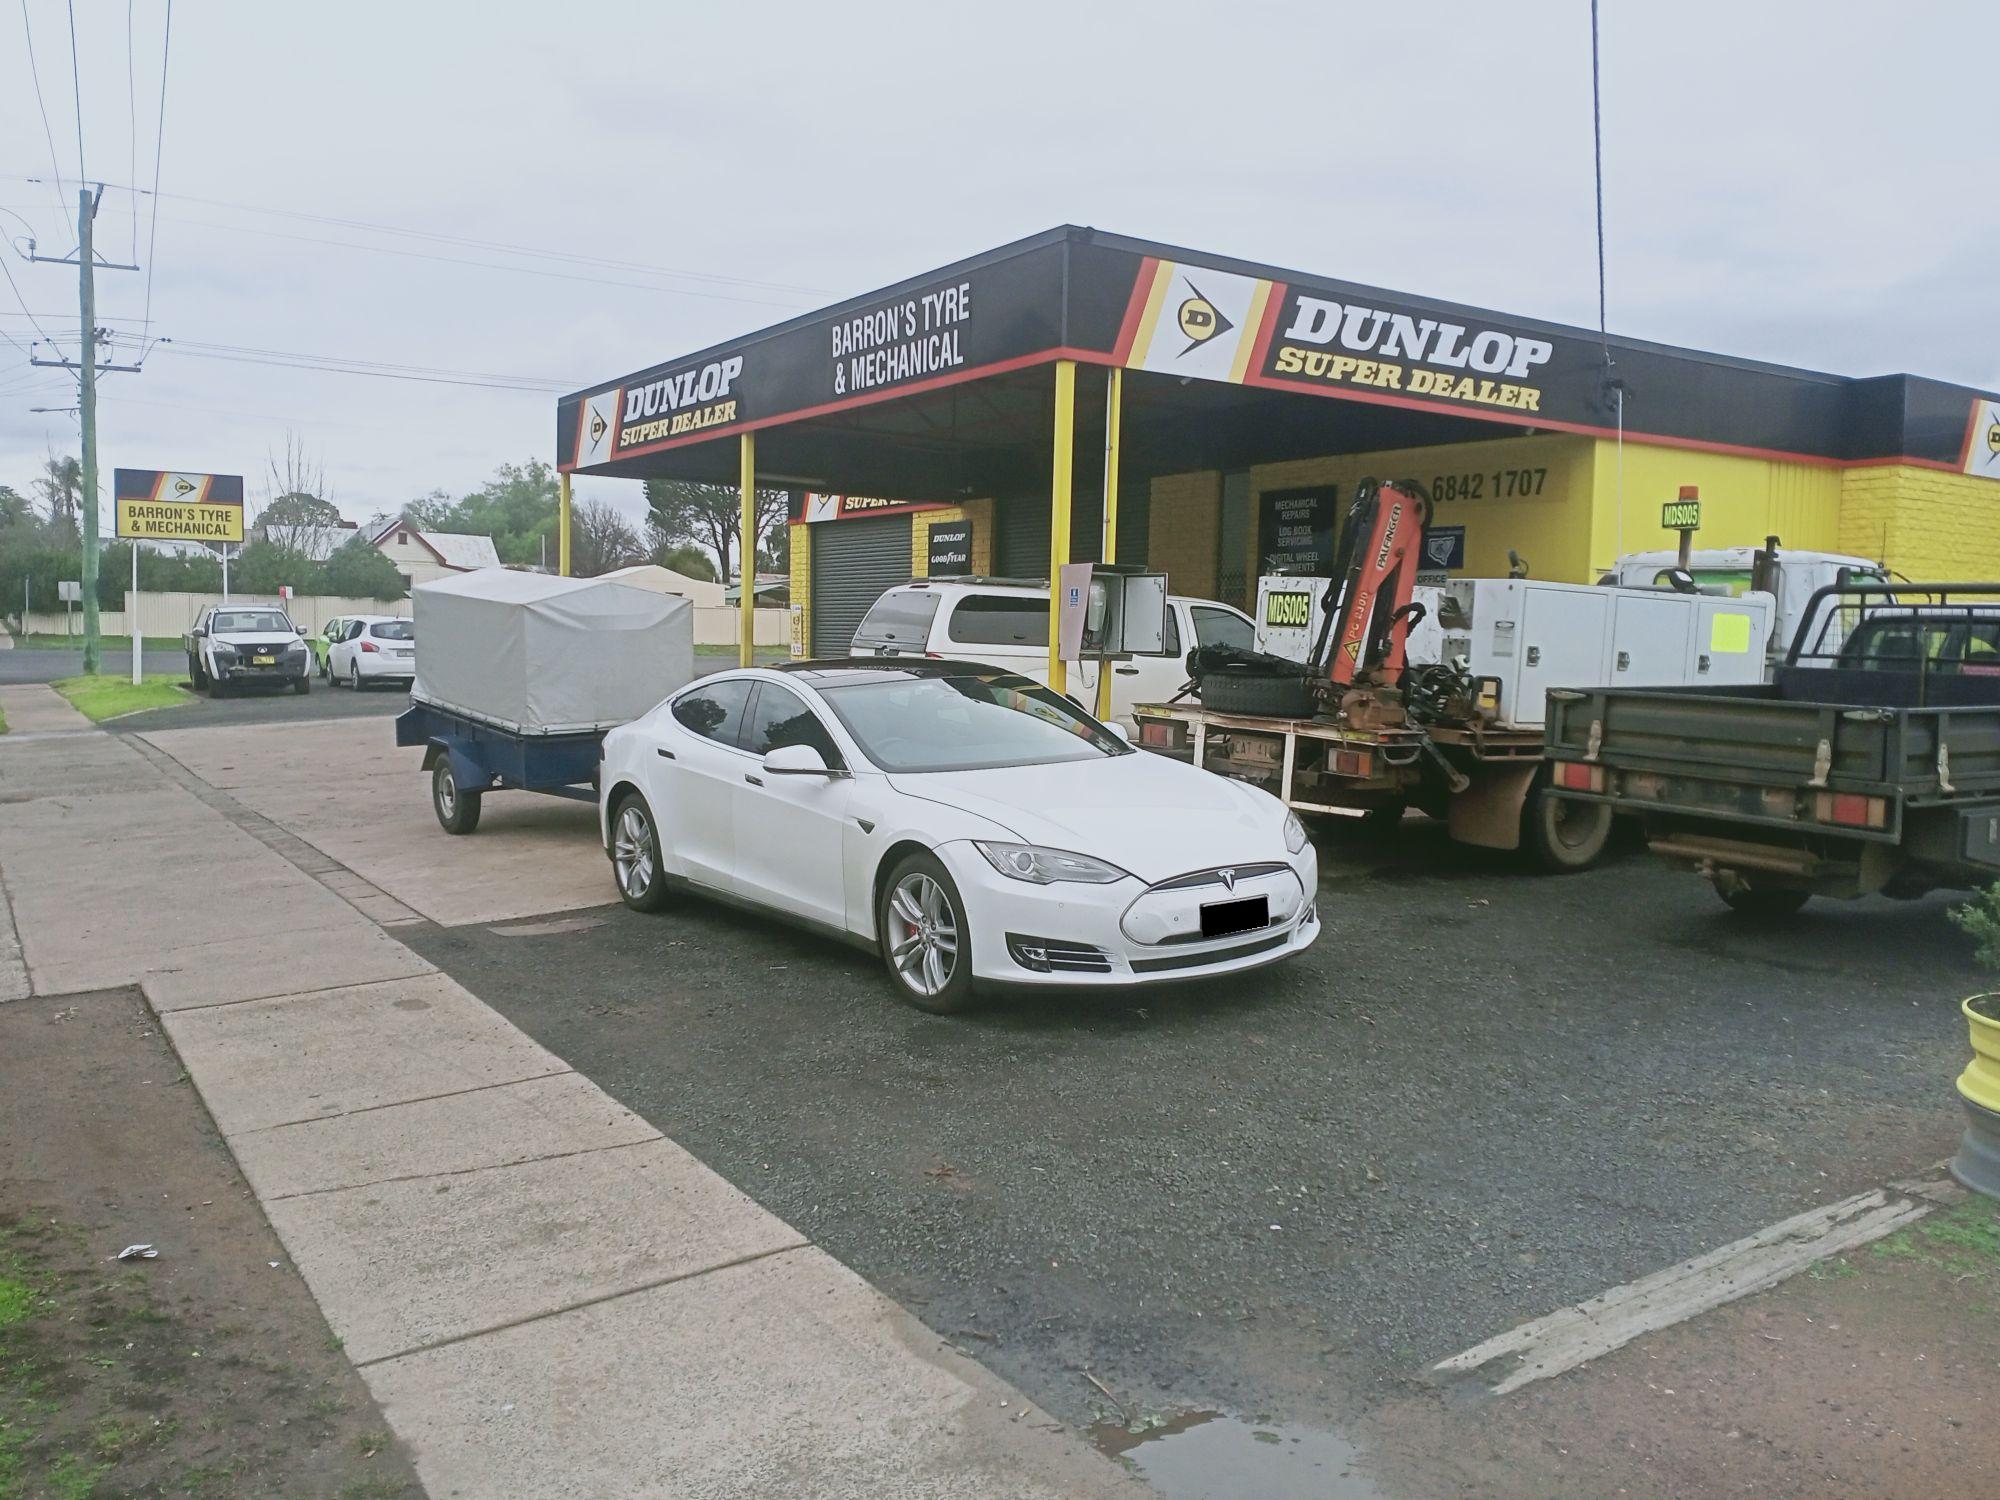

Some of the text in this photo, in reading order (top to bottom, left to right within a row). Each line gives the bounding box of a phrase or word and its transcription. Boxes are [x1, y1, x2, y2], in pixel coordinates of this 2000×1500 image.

[832, 282, 970, 358] BARRON'S TYRE
[1185, 310, 1212, 328] D
[1284, 295, 1553, 378] DUNLOP
[834, 329, 964, 395] & MECHANICAL
[1275, 346, 1541, 411] SUPER DEALER
[623, 355, 744, 423] DUNLOP
[620, 400, 737, 447] SUPER DEALER
[1432, 468, 1548, 502] 6842 1707
[128, 505, 232, 522] BARRON'S TYRE
[1274, 498, 1318, 511] MECHANICAL
[1281, 509, 1311, 520] REPAIRS
[1664, 504, 1698, 525] MDS005
[131, 519, 230, 536] & MECHANICAL
[1278, 525, 1313, 536] LOG BOOK
[933, 533, 966, 543] DUNLOP
[1277, 535, 1313, 547] SERVICING
[1377, 505, 1402, 569] PALFINGER
[931, 552, 966, 564] GOODYEAR
[1295, 551, 1320, 561] WHEEL
[1417, 574, 1447, 584] OFFICE
[1267, 594, 1309, 625] MDS005
